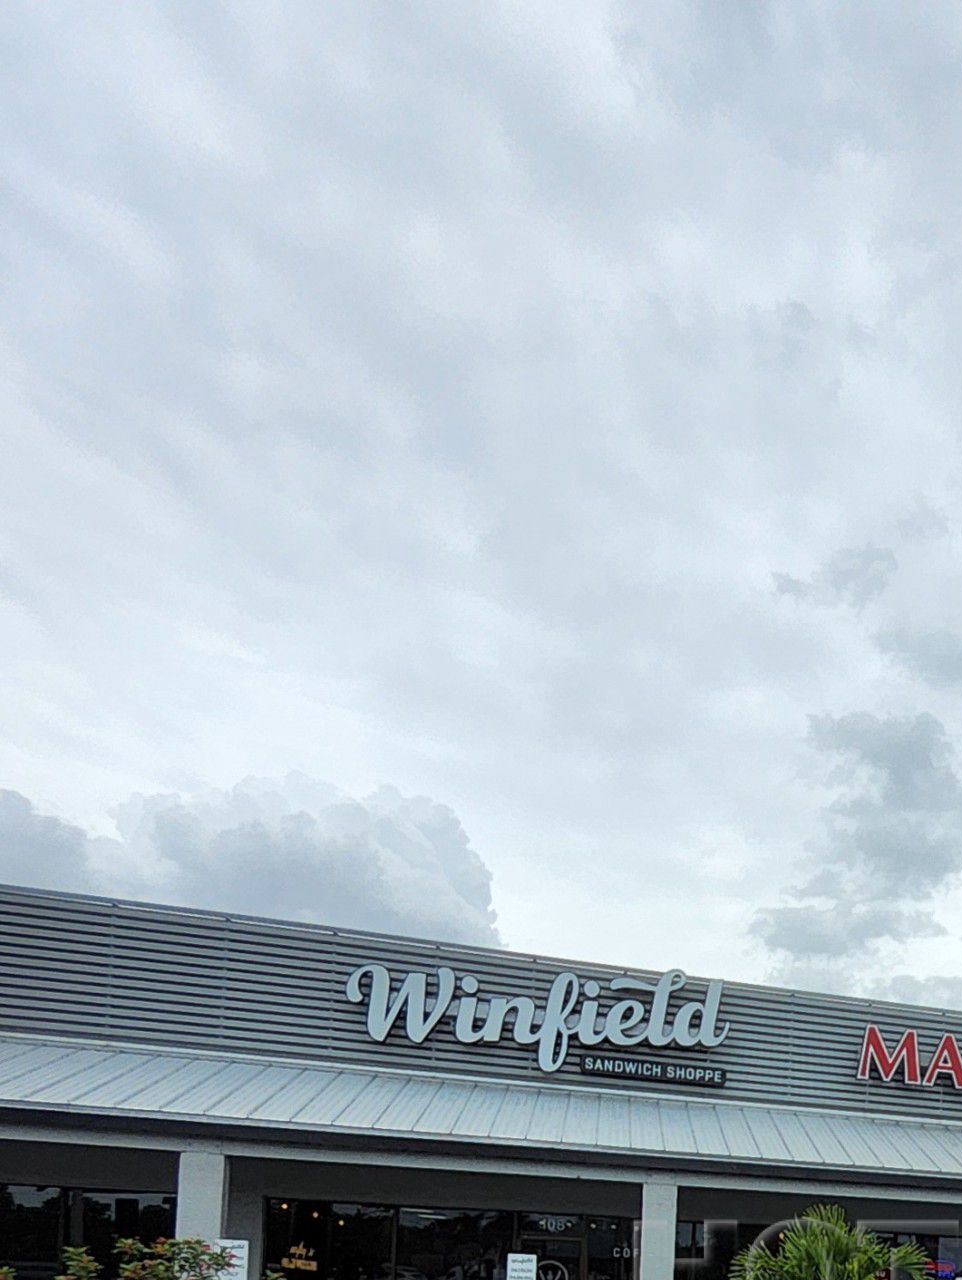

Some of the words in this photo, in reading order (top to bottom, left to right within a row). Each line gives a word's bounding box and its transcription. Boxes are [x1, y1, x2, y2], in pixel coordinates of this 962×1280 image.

[344, 963, 731, 1073] Winfield
[584, 1056, 662, 1078] SANDWICH
[665, 1065, 723, 1083] SHOPPE
